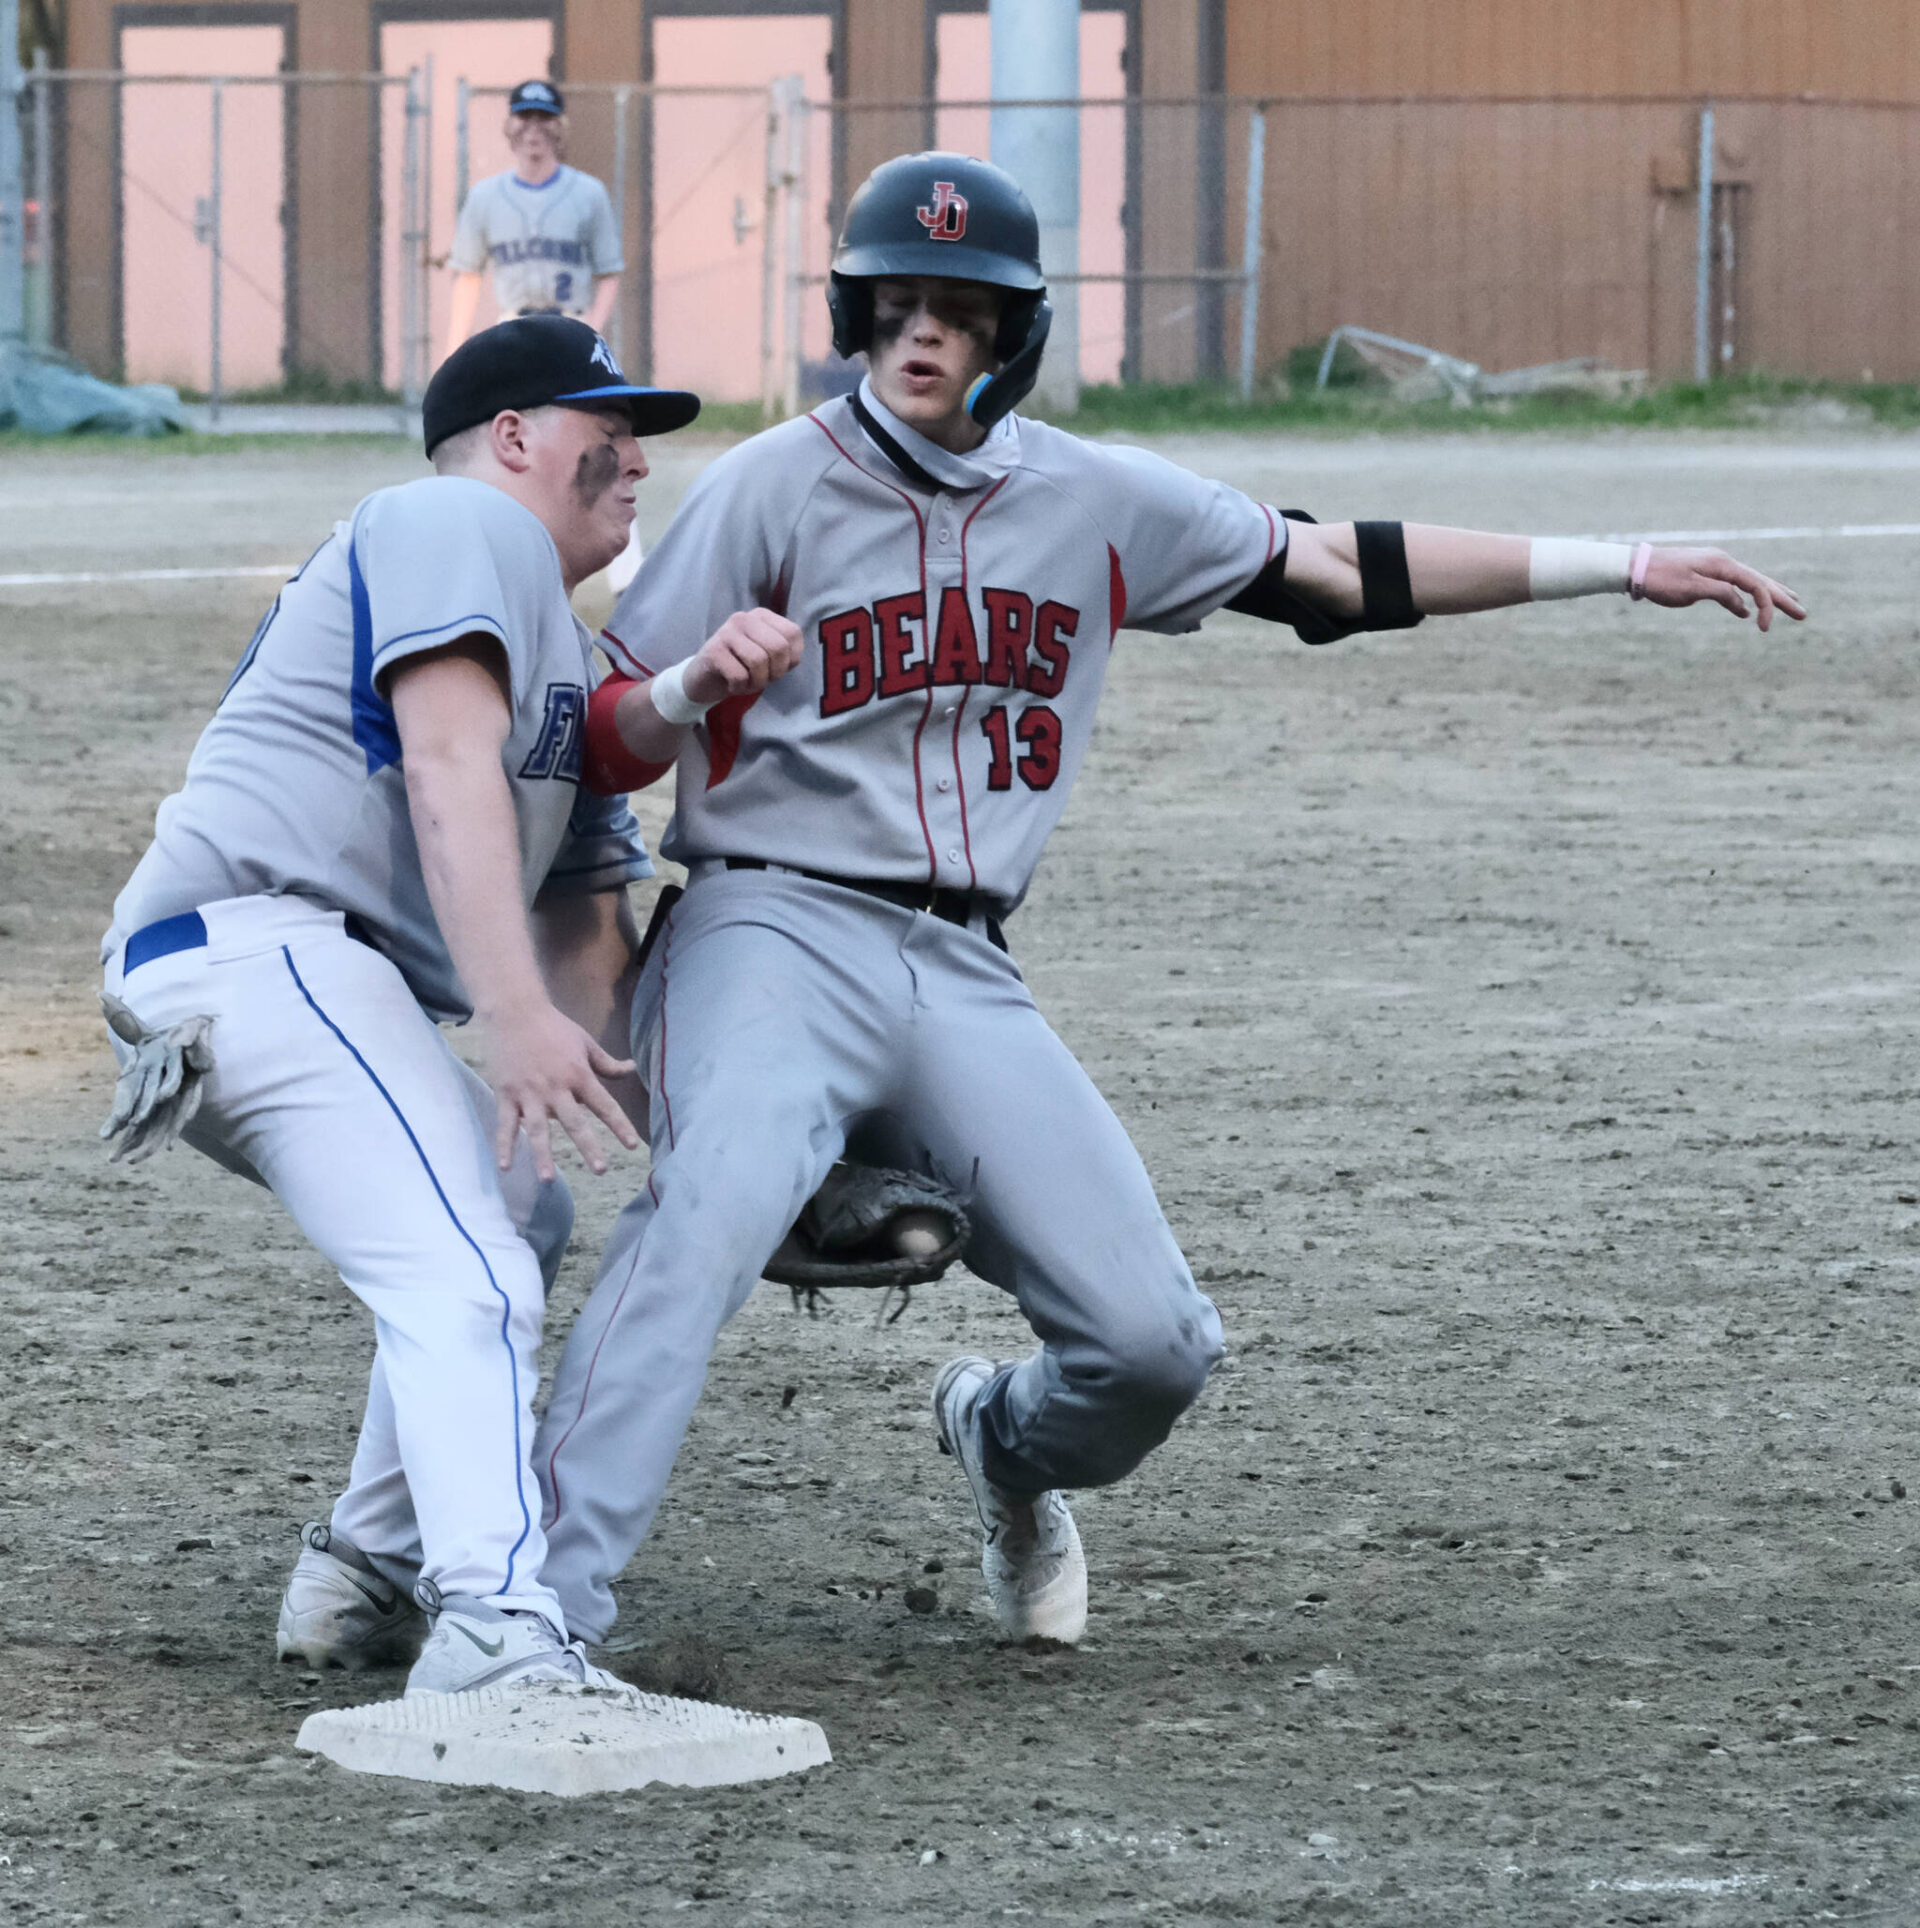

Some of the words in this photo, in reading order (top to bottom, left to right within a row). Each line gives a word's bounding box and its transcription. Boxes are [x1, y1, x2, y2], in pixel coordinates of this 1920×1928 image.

[917, 182, 968, 241] JD
[555, 272, 572, 301] 2
[819, 587, 1080, 719] BEARS
[980, 705, 1062, 791] 13
